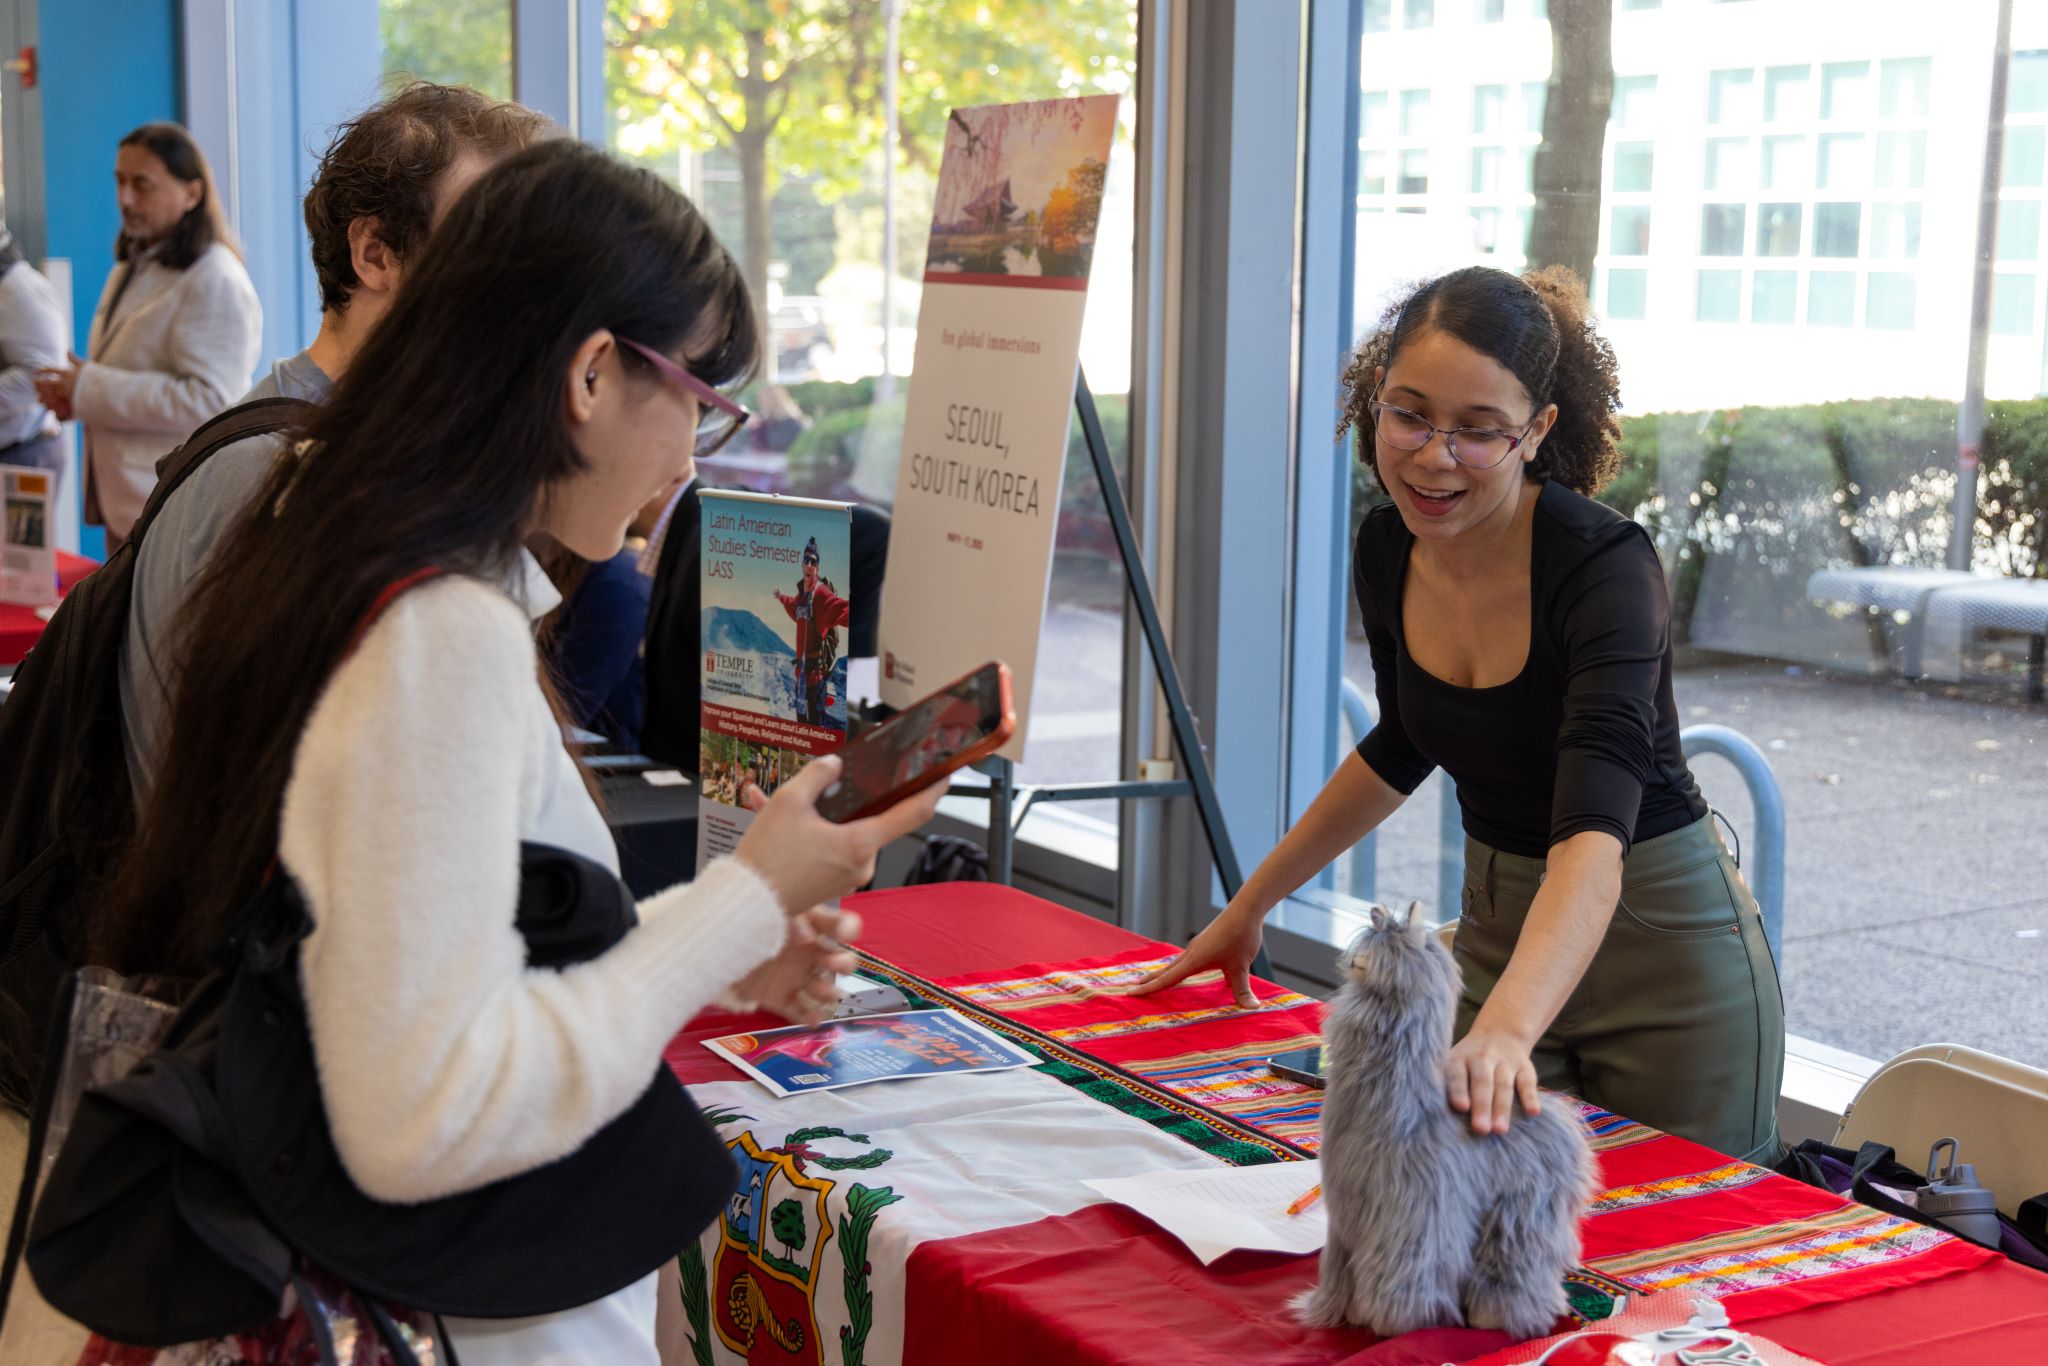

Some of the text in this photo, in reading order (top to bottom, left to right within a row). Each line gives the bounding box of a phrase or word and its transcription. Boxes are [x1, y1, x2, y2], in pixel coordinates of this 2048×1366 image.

[956, 330, 985, 351] global
[986, 333, 1041, 354] immersions
[945, 403, 1010, 459] SEOUL,
[910, 453, 1039, 517] SOUTH KOREA
[709, 511, 792, 537] Latin American
[708, 534, 801, 563] Studies Semester
[708, 559, 734, 580] LASS
[715, 653, 754, 673] TEMPLE
[732, 710, 754, 723] Spanish
[754, 716, 765, 726] and
[764, 718, 780, 729] Learn
[780, 721, 795, 733] about
[795, 725, 809, 736] Latin
[760, 728, 783, 742] Religion
[782, 735, 793, 744] and
